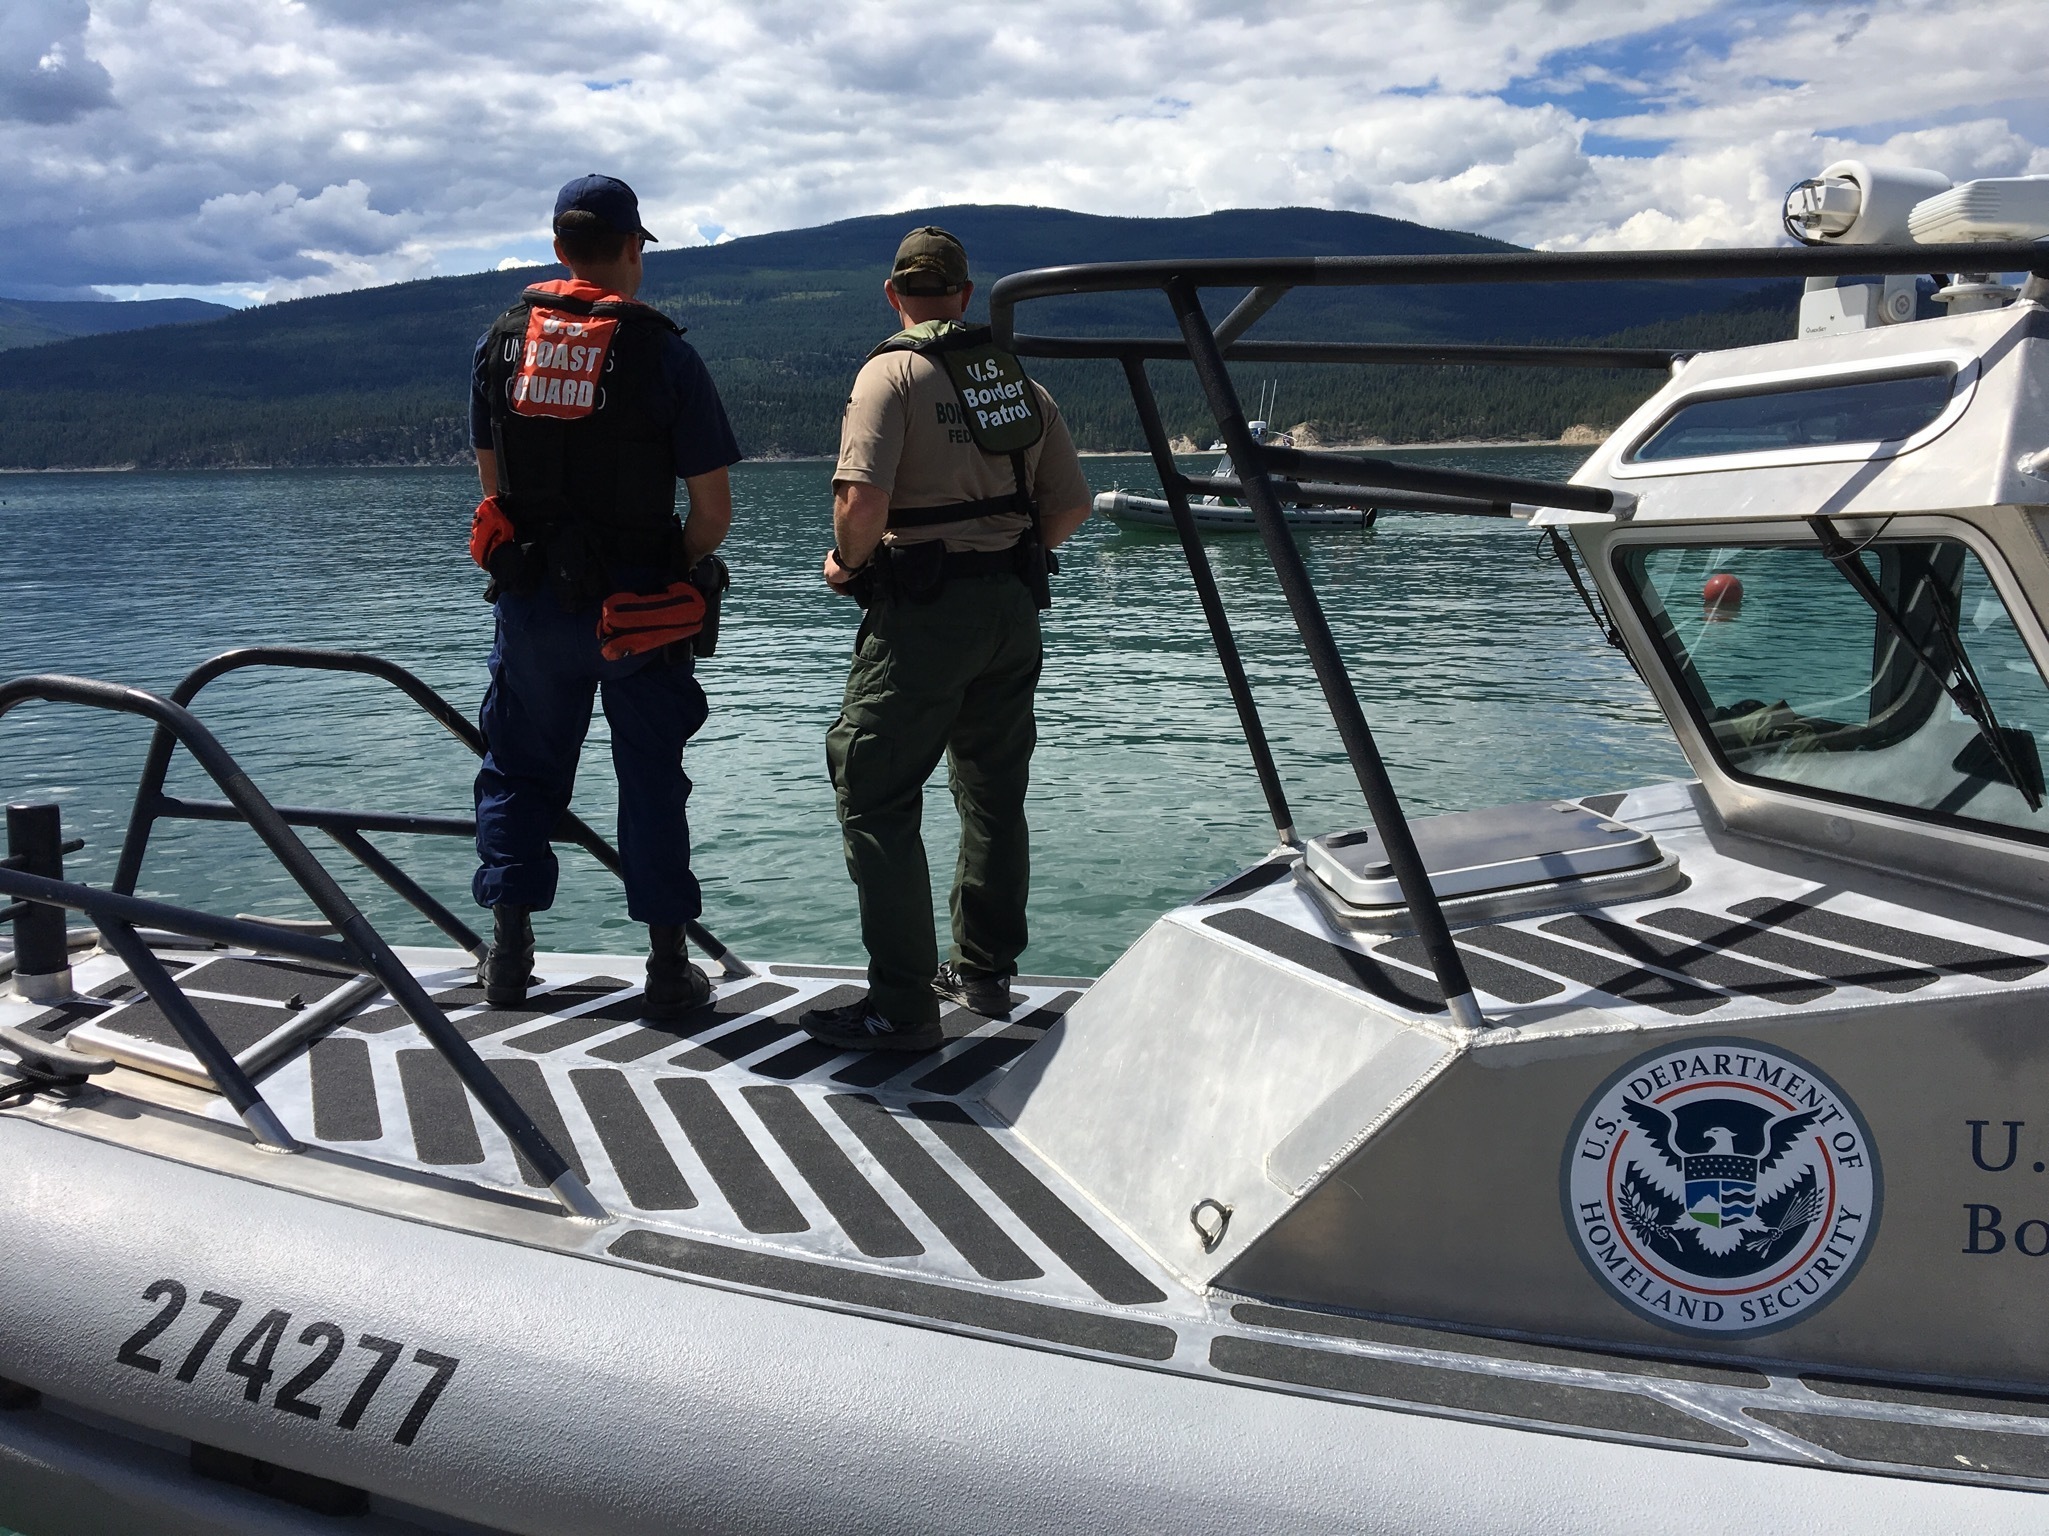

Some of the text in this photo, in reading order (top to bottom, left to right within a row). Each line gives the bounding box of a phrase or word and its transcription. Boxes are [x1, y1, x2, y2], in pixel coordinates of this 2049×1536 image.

[525, 340, 601, 372] COAST
[966, 358, 1004, 382] U.S.
[514, 375, 594, 408] GUARD
[963, 380, 1024, 408] Border
[976, 399, 1032, 430] Patrol
[1581, 1054, 1864, 1169] U.S. DEPARTMENT OF
[1962, 1203, 2049, 1257] Bo
[1579, 1199, 1862, 1323] HOMELAND SECURITY
[117, 1278, 460, 1447] 274277
